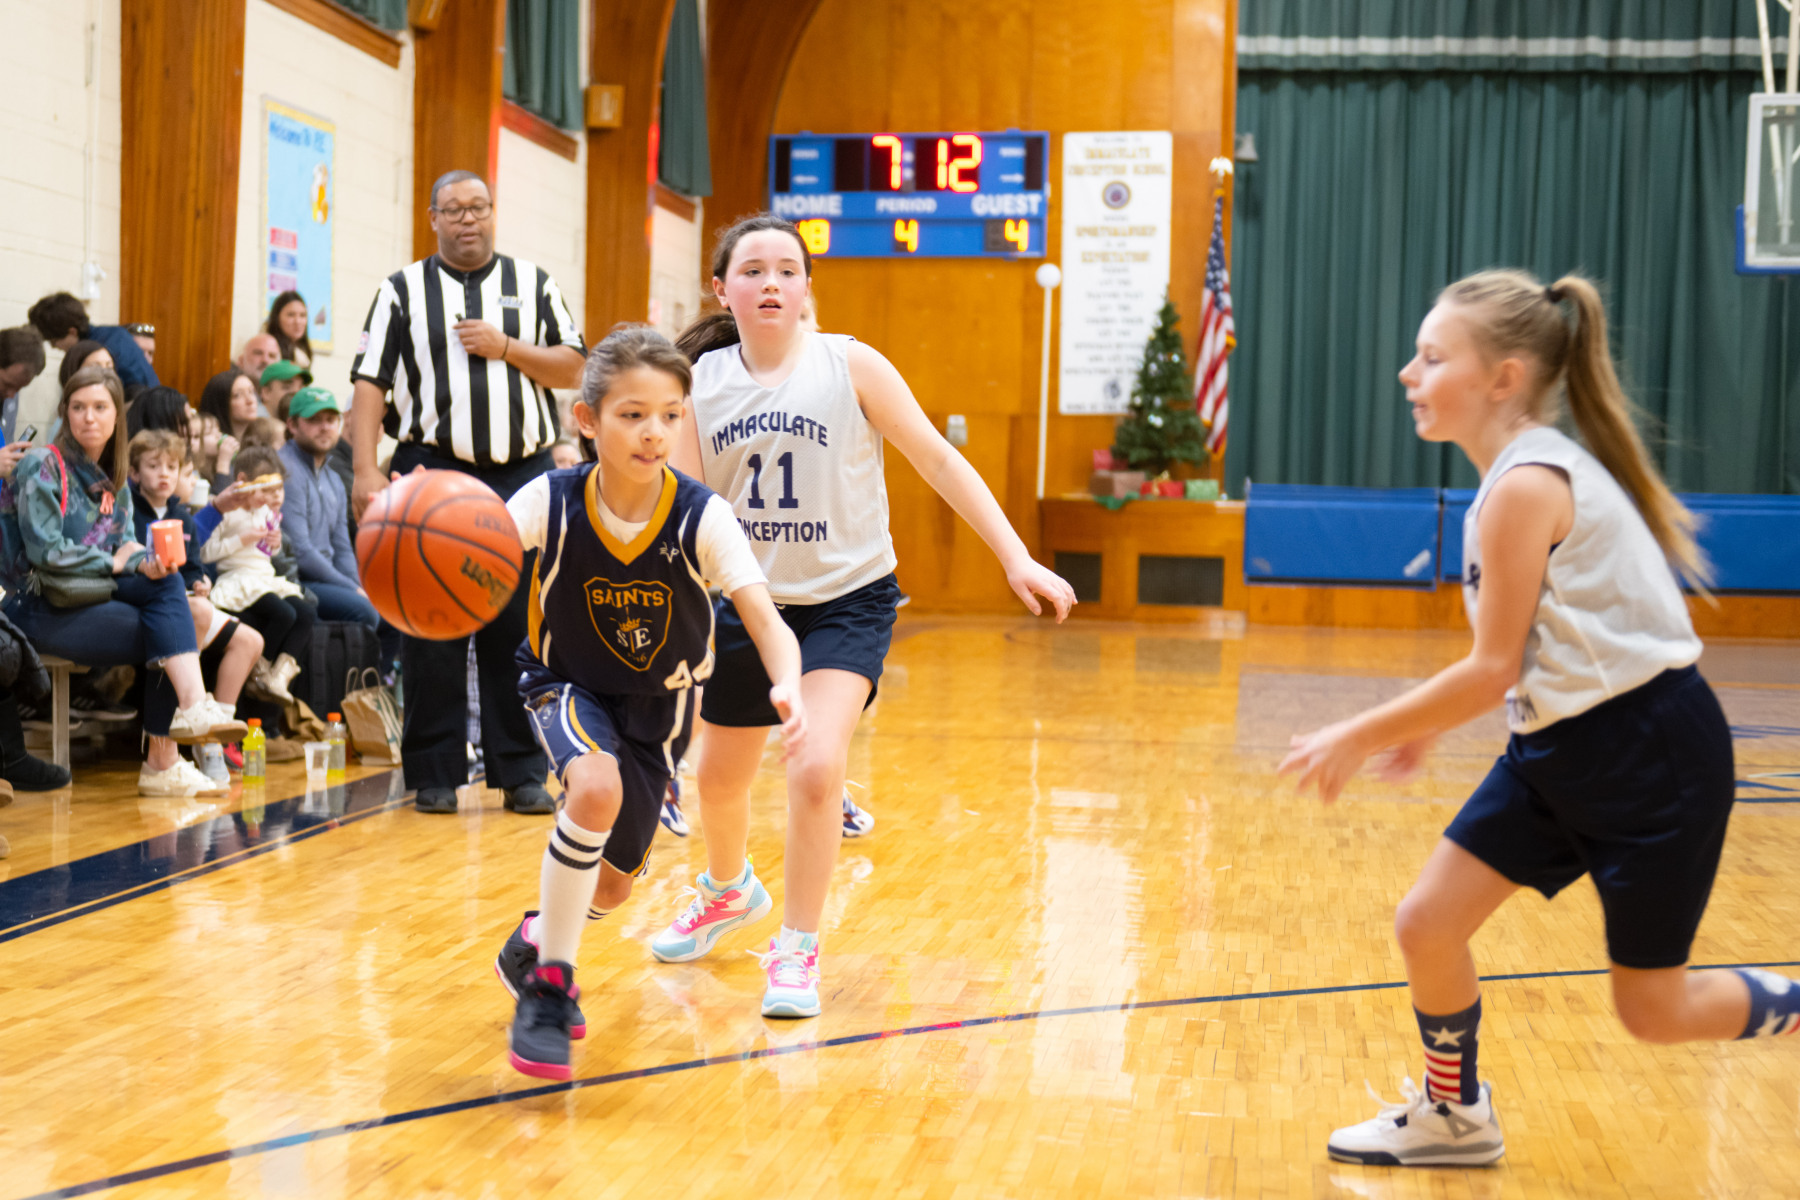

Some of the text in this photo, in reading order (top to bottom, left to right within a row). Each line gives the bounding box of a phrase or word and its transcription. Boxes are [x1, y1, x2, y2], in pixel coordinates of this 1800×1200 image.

[773, 195, 843, 216] HOME
[876, 198, 937, 214] PERIOD
[971, 196, 1042, 216] GUEST
[894, 218, 919, 253] 4
[1004, 218, 1029, 253] 4
[712, 411, 828, 456] IMMACULATE
[747, 451, 799, 509] 11
[736, 517, 827, 543] NCEPTION
[591, 588, 665, 608] SAINTS
